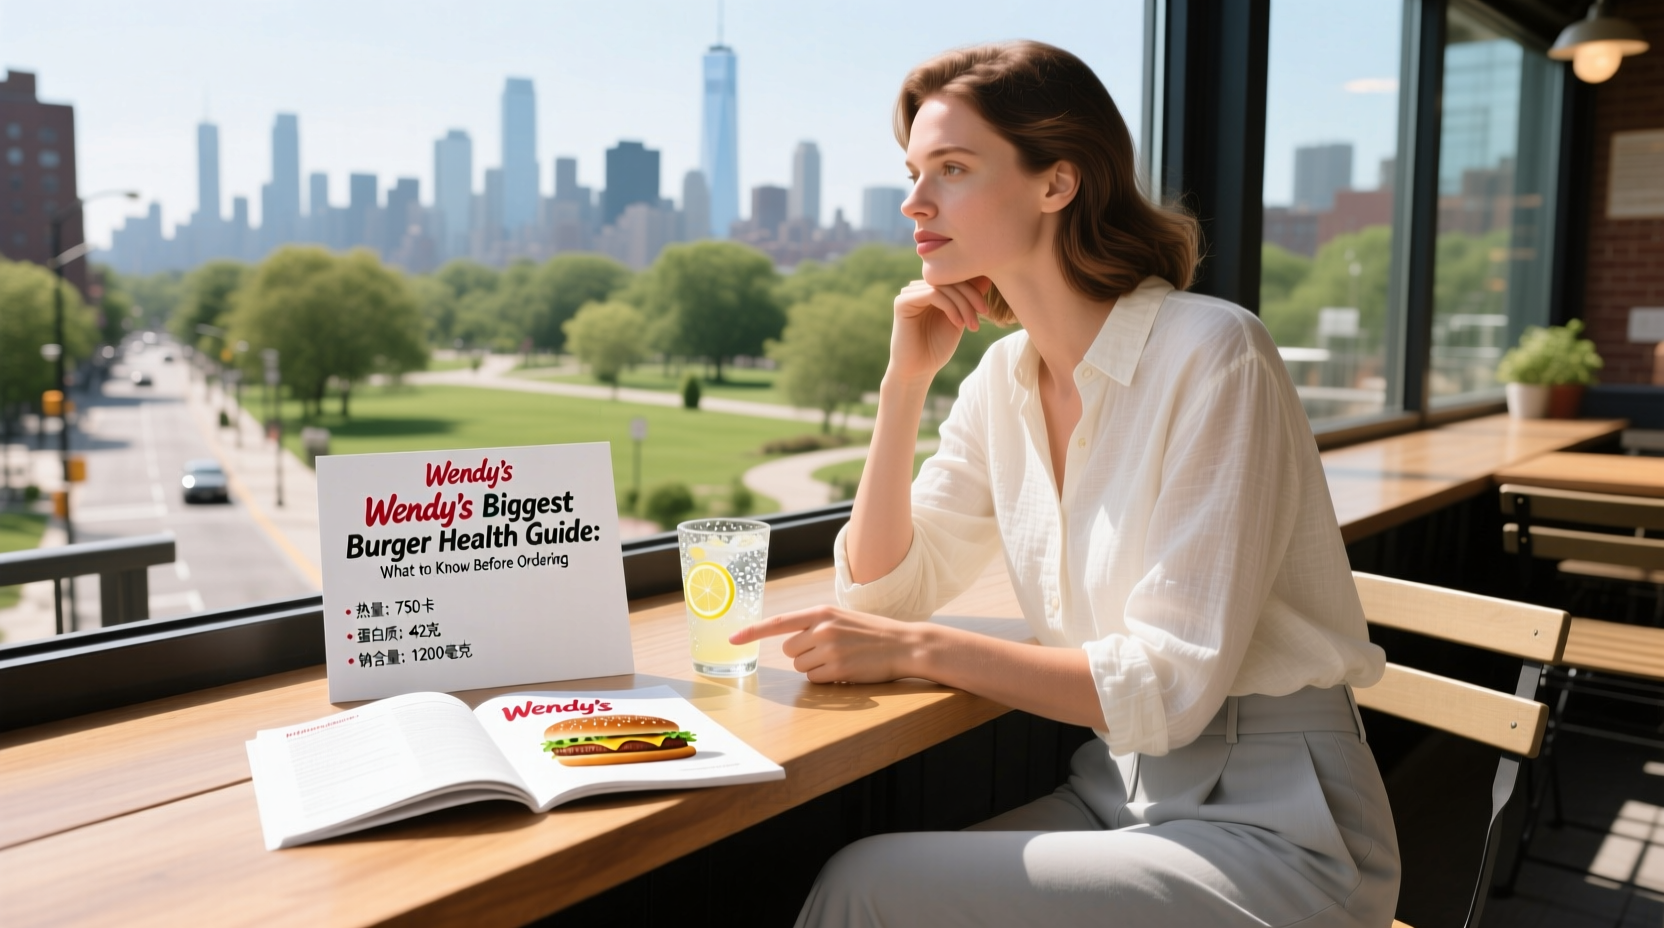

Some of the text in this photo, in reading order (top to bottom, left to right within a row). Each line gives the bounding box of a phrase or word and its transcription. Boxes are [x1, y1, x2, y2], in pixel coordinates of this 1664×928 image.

[425, 458, 513, 489] Wendy's
[365, 491, 574, 528] Wendy's Biggest
[346, 518, 601, 562] Burger Health Guide:
[380, 552, 569, 579] What to Know Before Ordering
[501, 699, 613, 721] Wendy's
